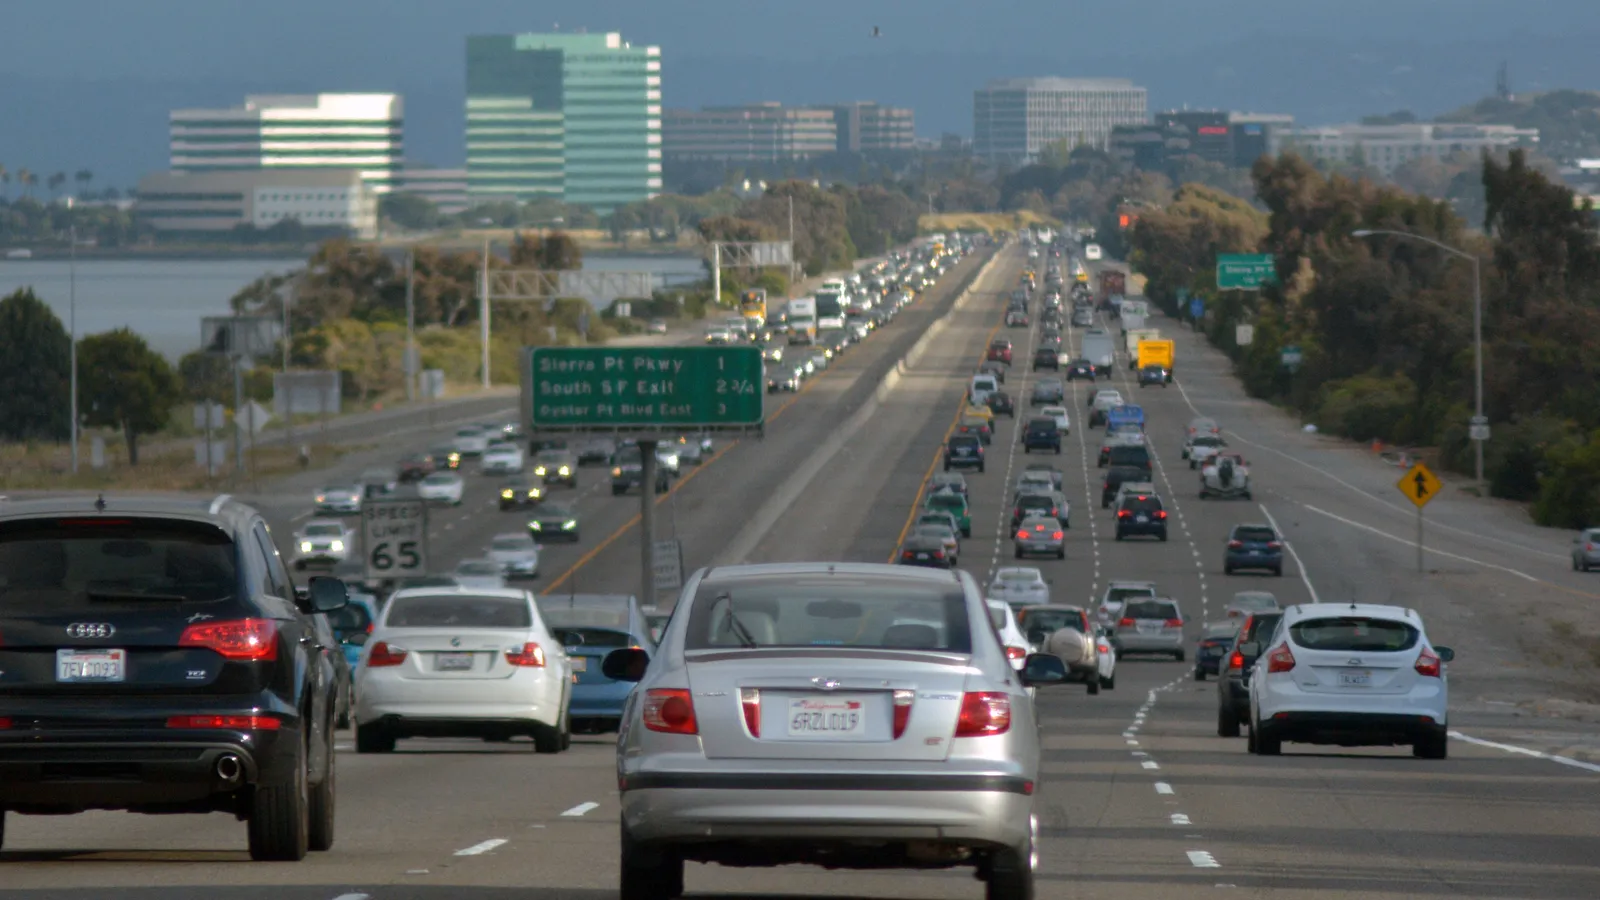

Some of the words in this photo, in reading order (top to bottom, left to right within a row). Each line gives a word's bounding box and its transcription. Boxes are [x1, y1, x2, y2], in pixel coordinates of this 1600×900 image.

[539, 357, 595, 371] Sierra
[604, 356, 624, 370] Pt
[633, 356, 684, 373] Pkwy
[718, 356, 724, 371] 1
[539, 380, 592, 394] South
[637, 380, 674, 394] Exit
[716, 379, 728, 394] 2
[539, 404, 589, 417] Oyster
[597, 404, 614, 416] Pt
[621, 403, 653, 415] Blvd
[660, 403, 692, 415] East
[718, 403, 727, 416] 3
[368, 506, 420, 520] SPEED
[371, 524, 417, 539] LIMIT
[371, 541, 421, 571] 65
